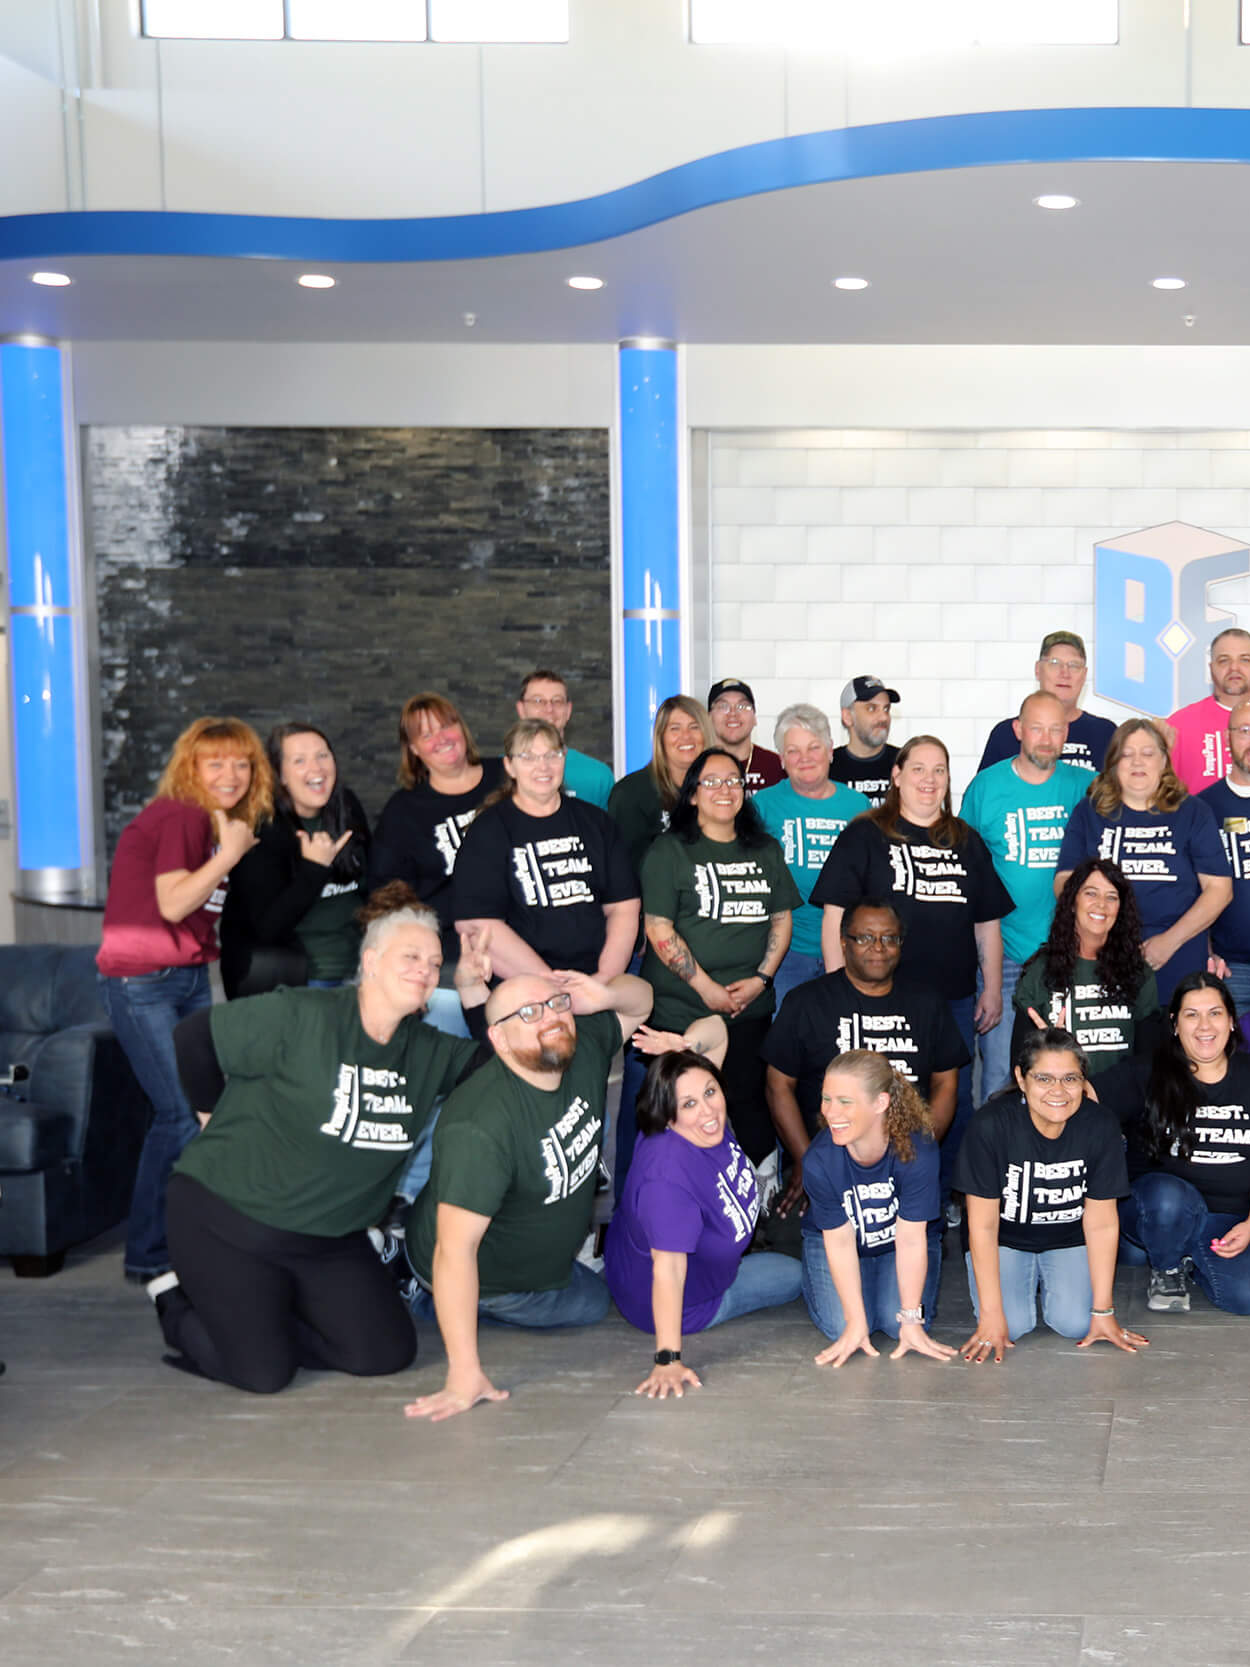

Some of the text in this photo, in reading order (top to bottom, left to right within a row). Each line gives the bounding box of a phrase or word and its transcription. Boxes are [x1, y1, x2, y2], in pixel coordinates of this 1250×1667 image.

[1062, 742, 1091, 756] EST.
[1025, 806, 1069, 820] BEST.
[1124, 825, 1173, 839] BEST.
[536, 836, 585, 857] BEST.
[910, 844, 959, 861] BEST.
[1122, 840, 1177, 854] TEAM.
[542, 857, 593, 878] TEAM.
[715, 861, 763, 876] BEST.
[913, 861, 968, 877] TEAM.
[1120, 859, 1169, 875] EVER.
[548, 880, 592, 900] EVER.
[721, 879, 772, 894] TEAM.
[914, 880, 962, 895] EVER.
[721, 900, 766, 916] EVER.
[1075, 1004, 1132, 1021] TEAM.
[861, 1015, 911, 1031] BEST.
[1076, 1027, 1124, 1045] EVER.
[862, 1037, 918, 1053] TEAM.
[1194, 1105, 1250, 1121] BEST.
[356, 1119, 408, 1141] EVER.
